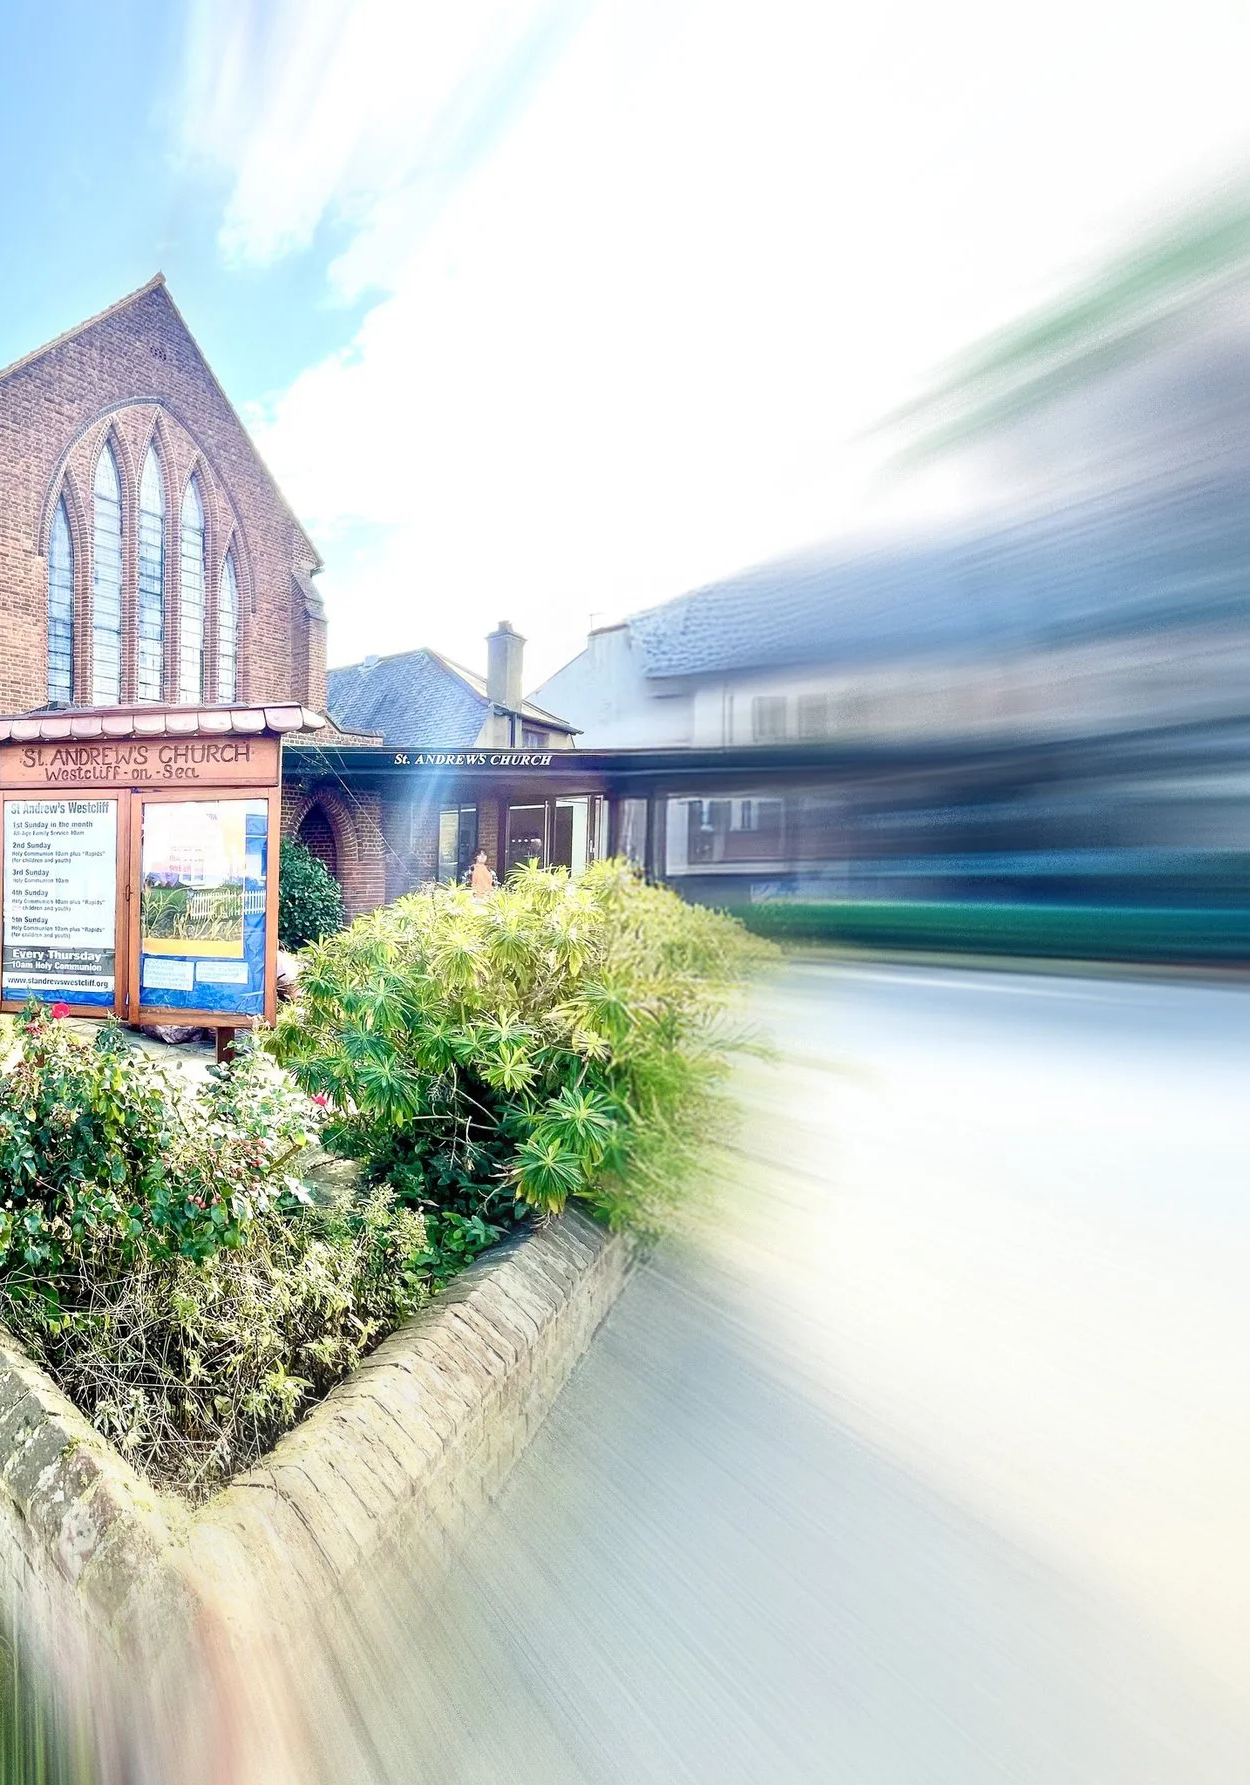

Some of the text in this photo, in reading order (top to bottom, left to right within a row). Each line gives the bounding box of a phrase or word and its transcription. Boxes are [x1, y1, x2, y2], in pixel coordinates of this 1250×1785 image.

[50, 745, 149, 766] ANDREW'S
[158, 743, 251, 764] CHURCH
[394, 753, 411, 765] St.
[490, 754, 553, 766] CHURCH
[11, 801, 110, 815] St Andrew's Westcliff
[13, 821, 23, 829] 1st
[24, 821, 49, 829] Sunday
[12, 841, 51, 850] 2nd Sunday
[25, 869, 50, 877] Sunday
[24, 889, 49, 897] Sunday
[24, 916, 49, 925] Sunday
[12, 949, 102, 963] Every Thursday
[11, 960, 102, 972] 10am Holy Communion
[7, 976, 109, 988] www.standrewswestcliff.org
